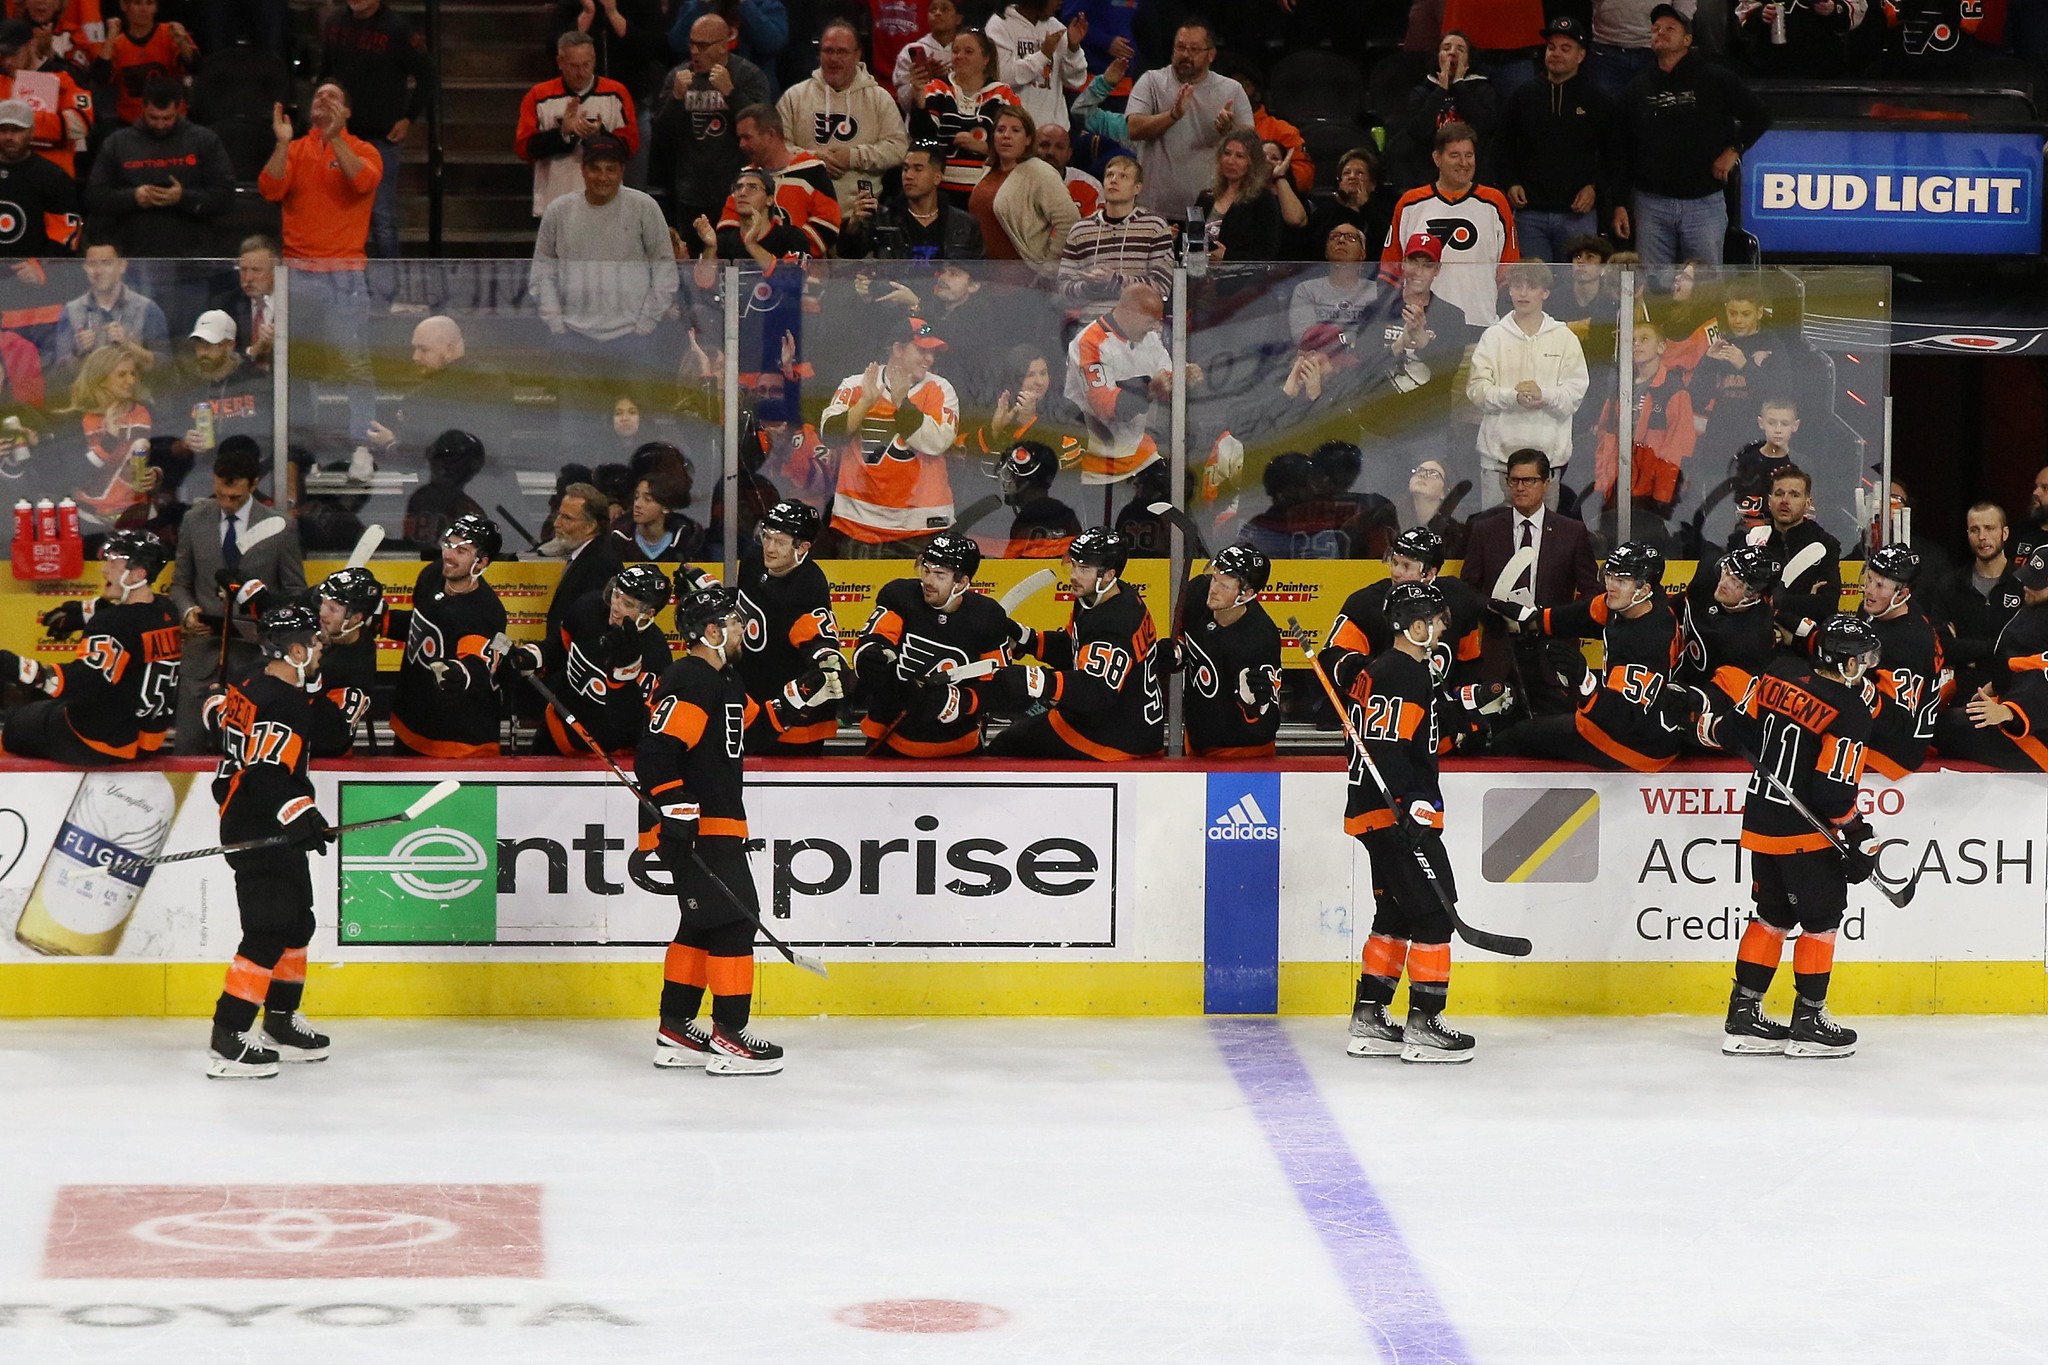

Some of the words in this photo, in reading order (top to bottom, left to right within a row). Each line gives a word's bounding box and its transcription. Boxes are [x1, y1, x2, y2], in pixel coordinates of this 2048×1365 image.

[124, 157, 184, 169] carhartt
[1762, 173, 1868, 211] BUD
[1875, 176, 2021, 214] LIGHT
[33, 545, 60, 555] BIO
[828, 582, 872, 593] Painters
[1275, 582, 1319, 592] Painters
[1083, 641, 1130, 690] 58
[1622, 663, 1664, 714] 54
[1364, 693, 1403, 743] 21
[247, 721, 292, 767] 77
[1827, 736, 1864, 786] 11
[1640, 788, 1745, 815] WELL
[1853, 788, 1905, 816] GO
[1208, 823, 1278, 841] adidas
[1638, 838, 1742, 884] ACT
[1875, 838, 2032, 885] CASH
[200, 925, 208, 947] Enjoy
[1636, 906, 1760, 942] Credit
[685, 1032, 704, 1044] CCM
[713, 1034, 751, 1059] CCM
[0, 1301, 642, 1328] TOYOTA
